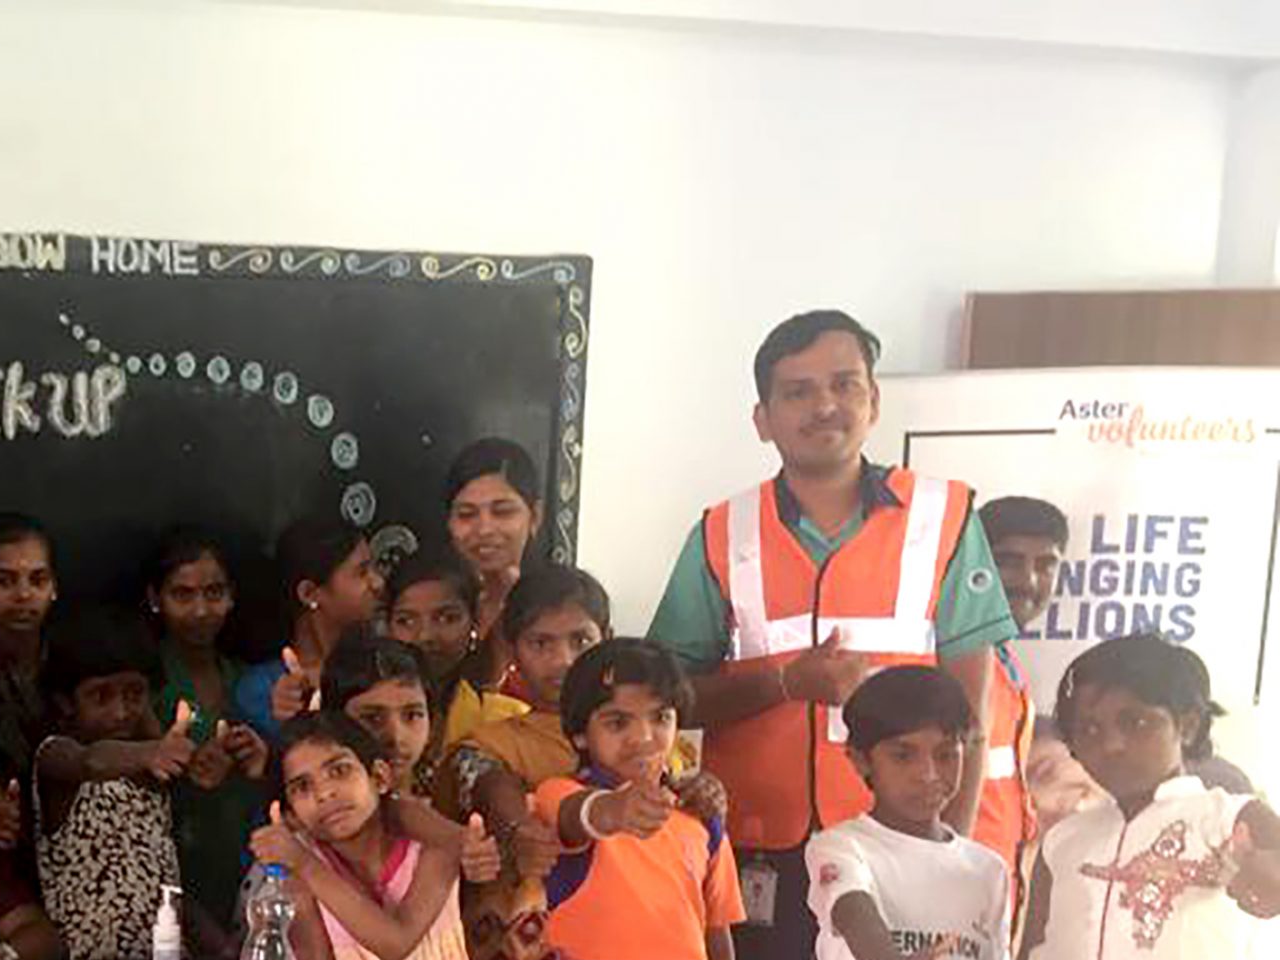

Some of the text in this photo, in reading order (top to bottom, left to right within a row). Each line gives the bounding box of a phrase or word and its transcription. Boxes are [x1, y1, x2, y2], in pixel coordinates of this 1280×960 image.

[90, 236, 201, 275] HOME
[1059, 400, 1129, 420] Aster
[1087, 405, 1255, 448] volunteers
[1090, 513, 1210, 555] LIFE
[1054, 559, 1202, 598] NGING
